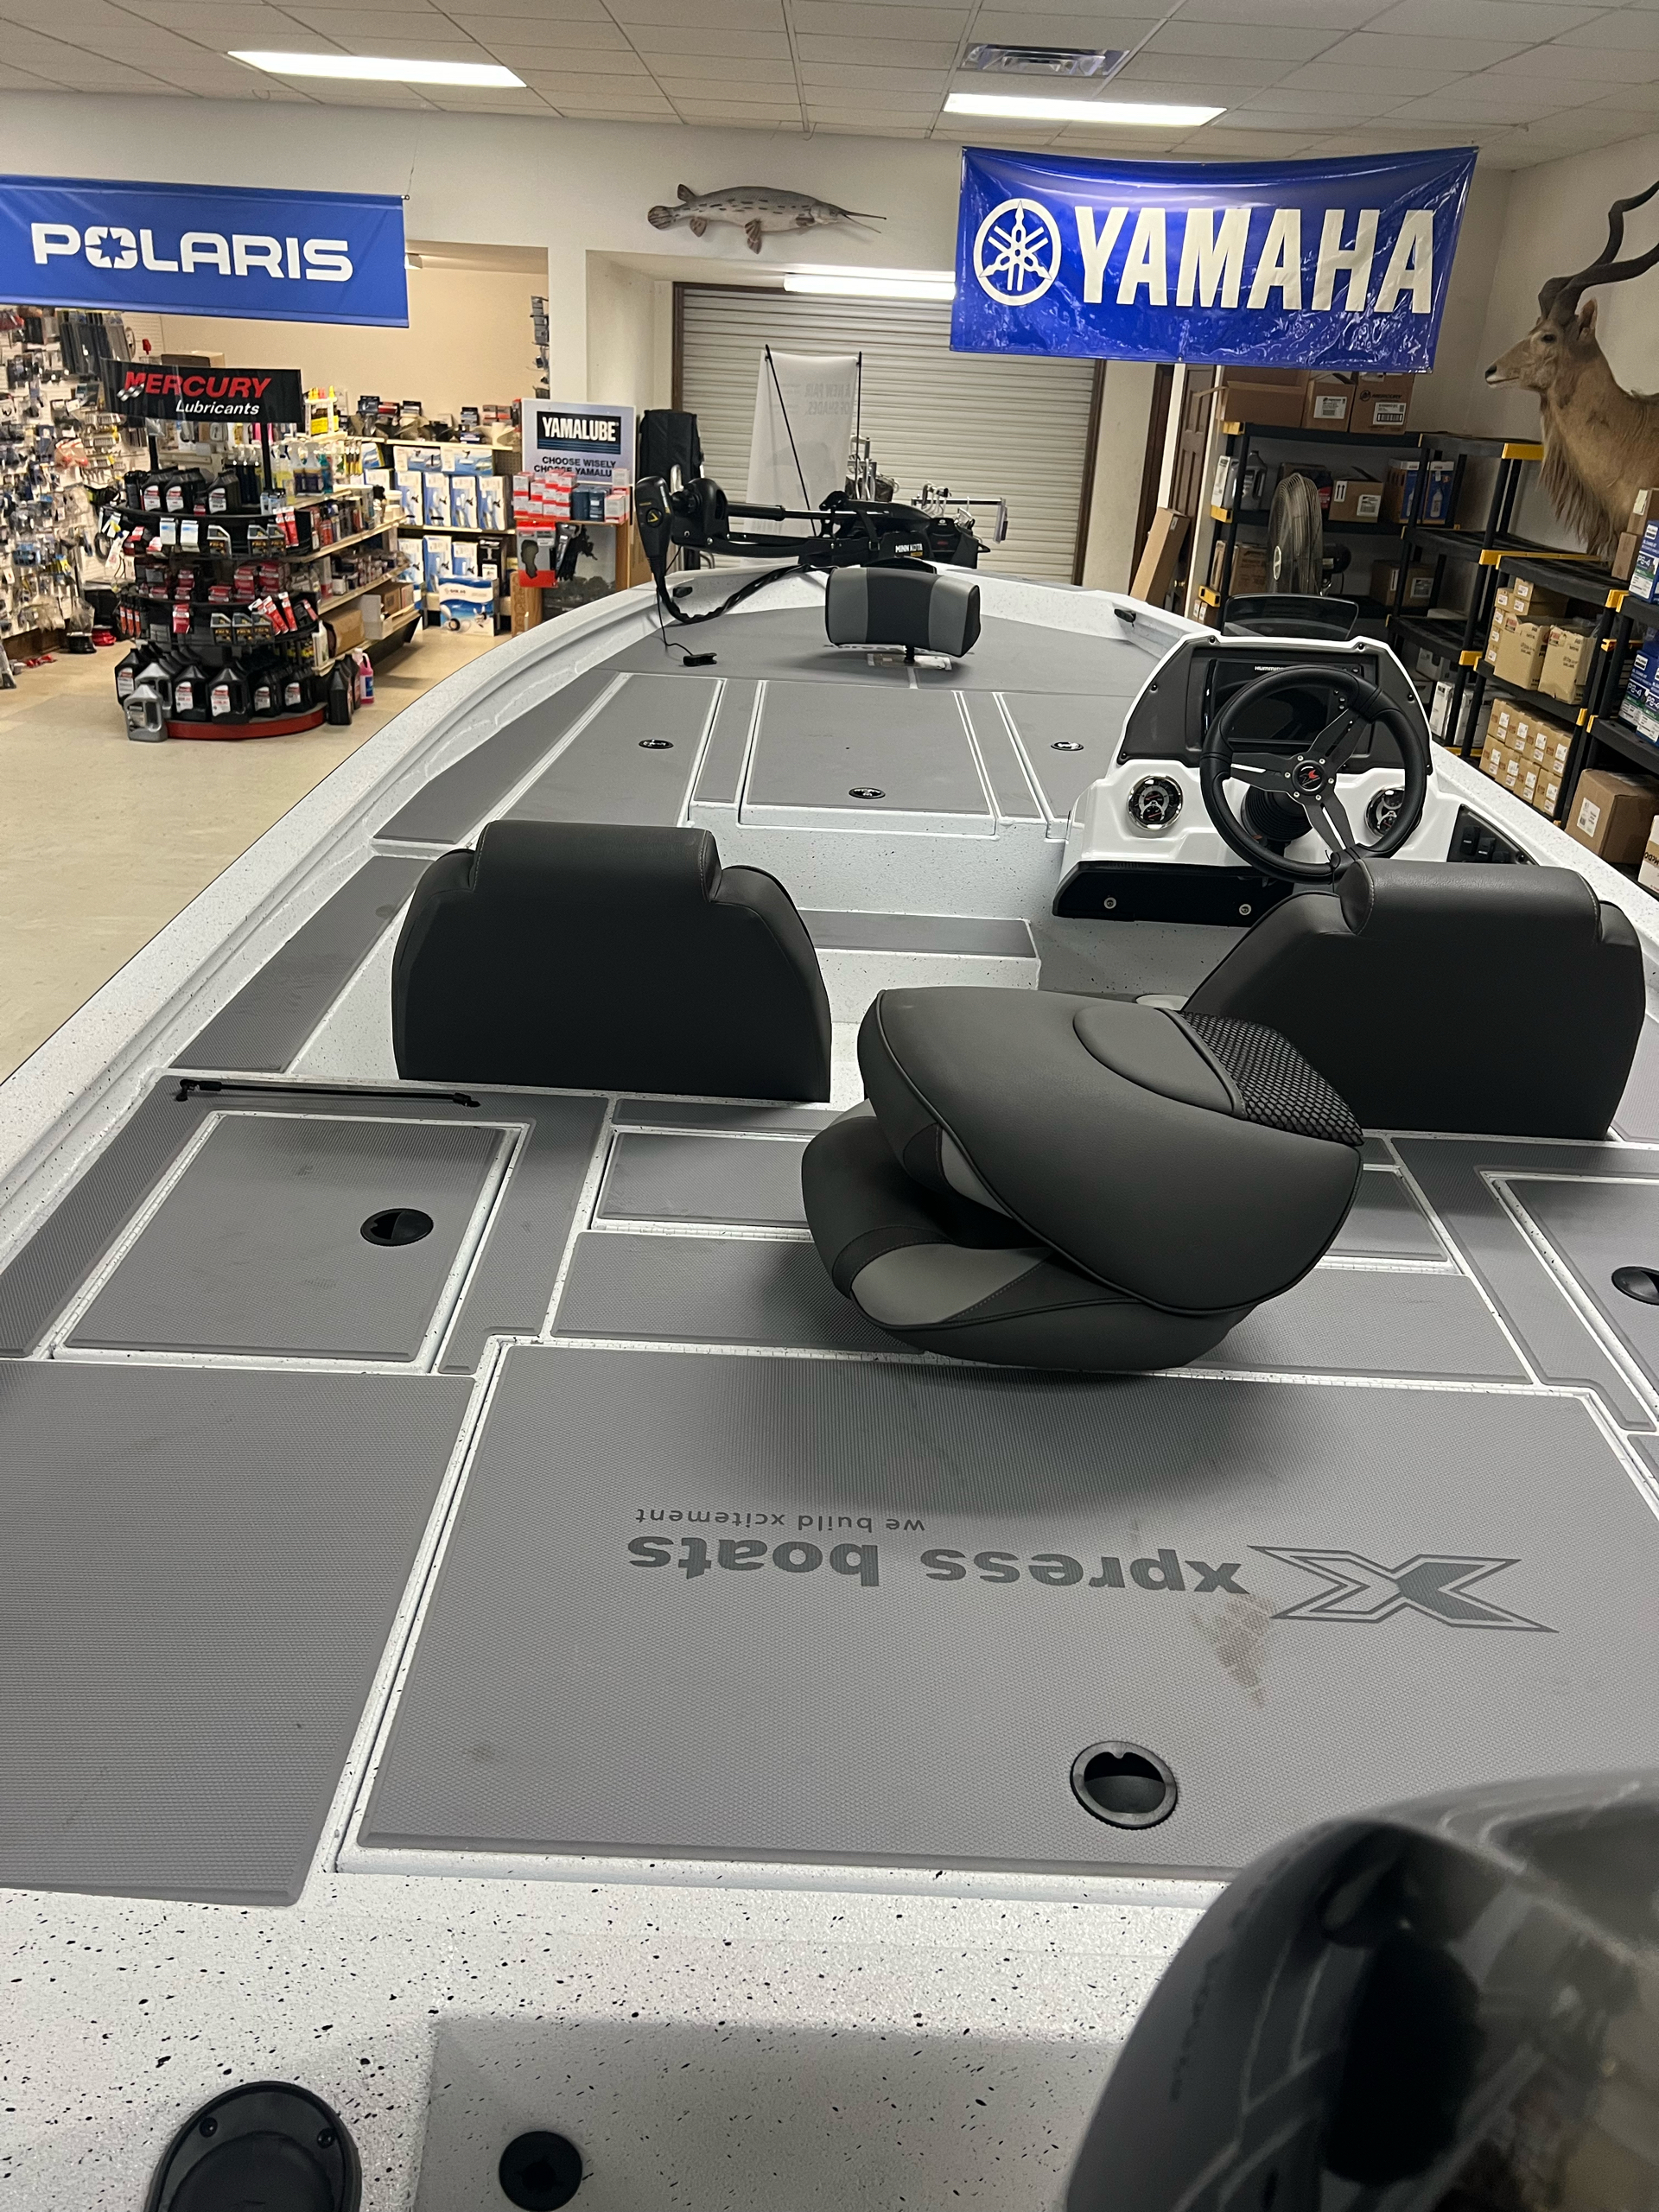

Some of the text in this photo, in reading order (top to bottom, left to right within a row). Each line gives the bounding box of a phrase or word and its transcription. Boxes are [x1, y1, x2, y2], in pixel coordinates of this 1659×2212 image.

[31, 223, 353, 282] POLARIS
[1075, 206, 1435, 315] YAMAHA
[123, 372, 272, 398] MERCURY
[175, 402, 260, 416] Lubricants
[542, 416, 617, 442] YAMALUBE
[543, 456, 616, 468] CHOOSE WISELY
[635, 1506, 925, 1535] we build xcitement
[627, 1537, 880, 1587] boats
[920, 1548, 1249, 1596] xpress
